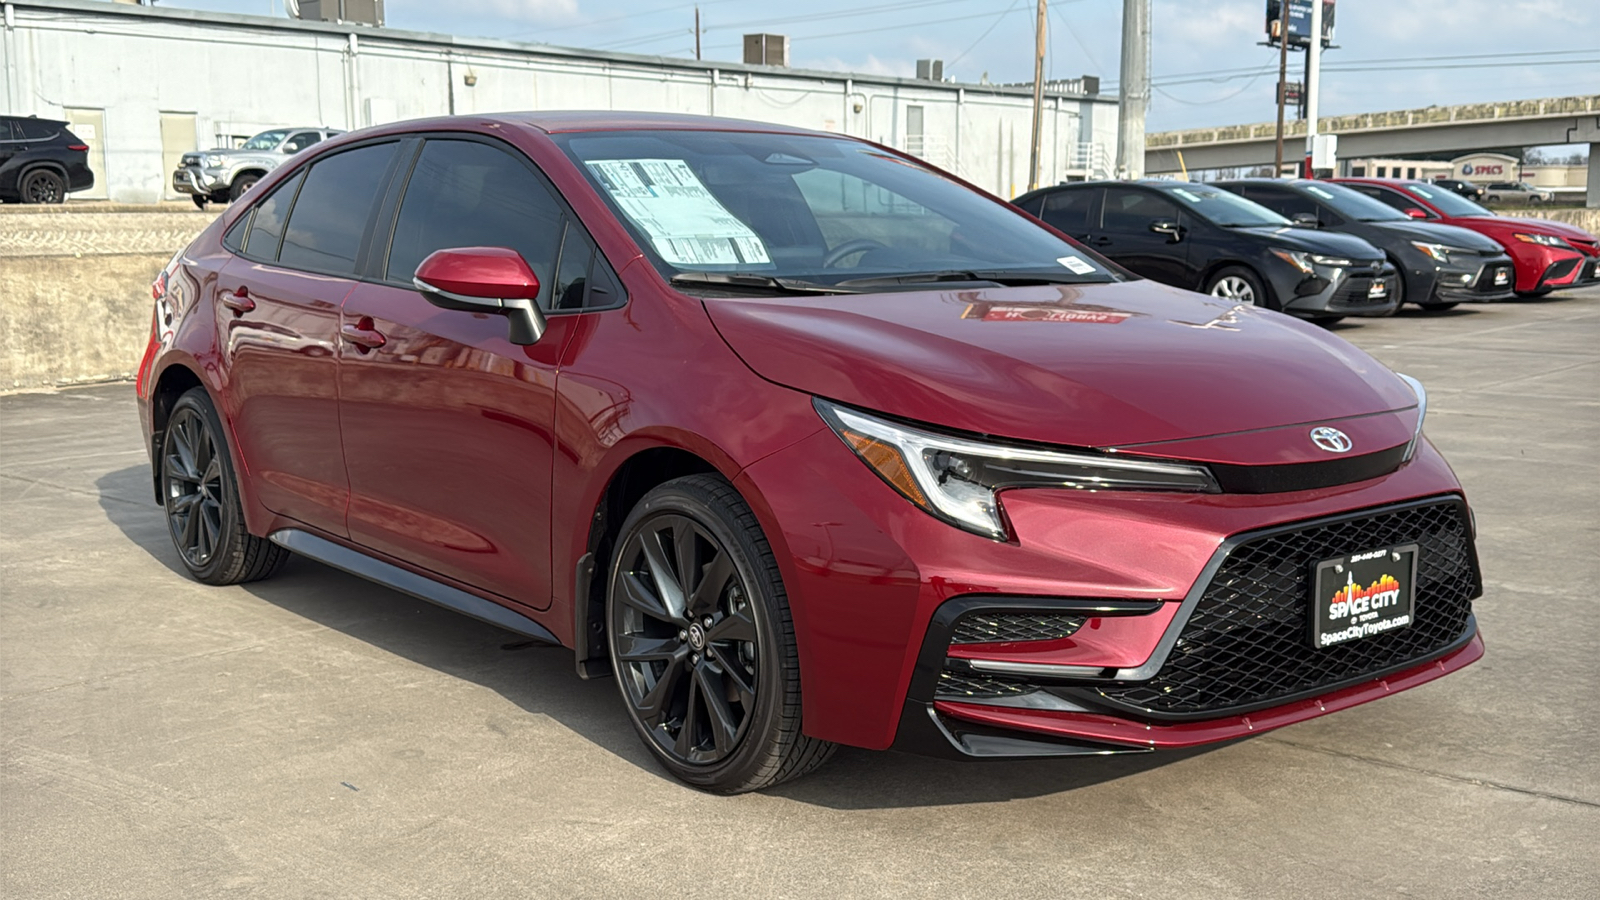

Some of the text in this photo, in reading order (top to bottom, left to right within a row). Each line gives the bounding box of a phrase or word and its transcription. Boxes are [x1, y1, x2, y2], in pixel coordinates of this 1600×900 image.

[1371, 589, 1400, 609] CITY
[1359, 611, 1379, 622] TOYOTA
[1320, 615, 1410, 646] SpaceCityToyota.com
